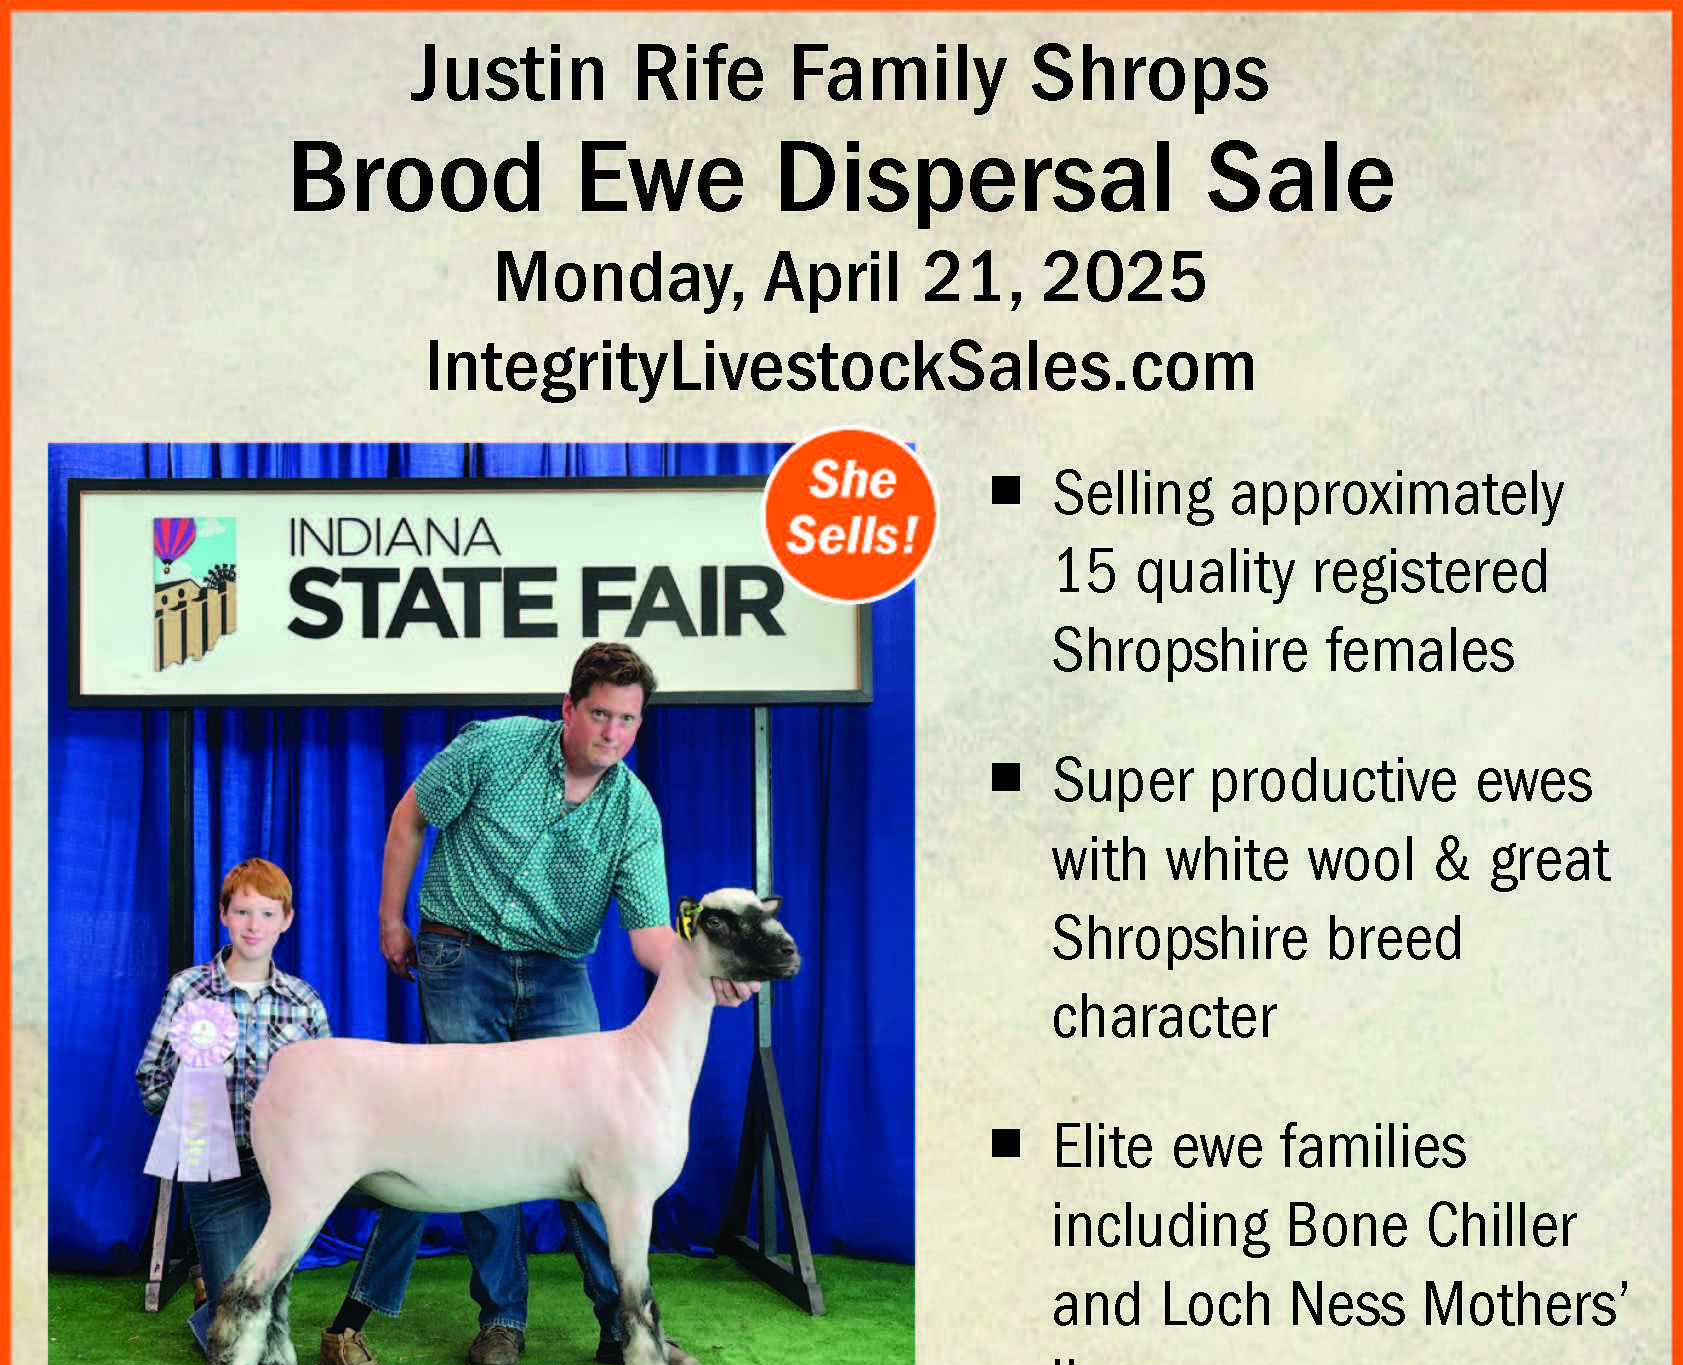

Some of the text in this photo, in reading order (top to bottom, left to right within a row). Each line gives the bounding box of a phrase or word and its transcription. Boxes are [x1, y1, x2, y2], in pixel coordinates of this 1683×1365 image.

[411, 43, 1268, 115] Justin Rife Family Shrops
[294, 140, 1393, 229] Brood Ewe Dispersal Sale
[498, 250, 1205, 314] Monday, April 21, 2025
[430, 339, 1253, 403] IntegrityLivestockSales.com
[810, 459, 896, 498] She
[1054, 469, 1564, 526] Selling approximately
[291, 518, 500, 556] INDIANA
[787, 515, 918, 554] Sells!
[288, 566, 785, 639] STATE FAIR
[1059, 547, 1546, 604] 15 quality registered
[1053, 626, 1514, 682] Shropshire females
[1054, 756, 1592, 812] Super productive ewes
[1052, 835, 1611, 892] with white wool & great
[1053, 914, 1460, 970] Shropshire breed
[1054, 993, 1277, 1038] character
[1057, 1122, 1466, 1168] Elite ewe families
[1055, 1201, 1577, 1258] including Bone Chiller
[1054, 1281, 1627, 1326] and Loch Ness Mothers’
